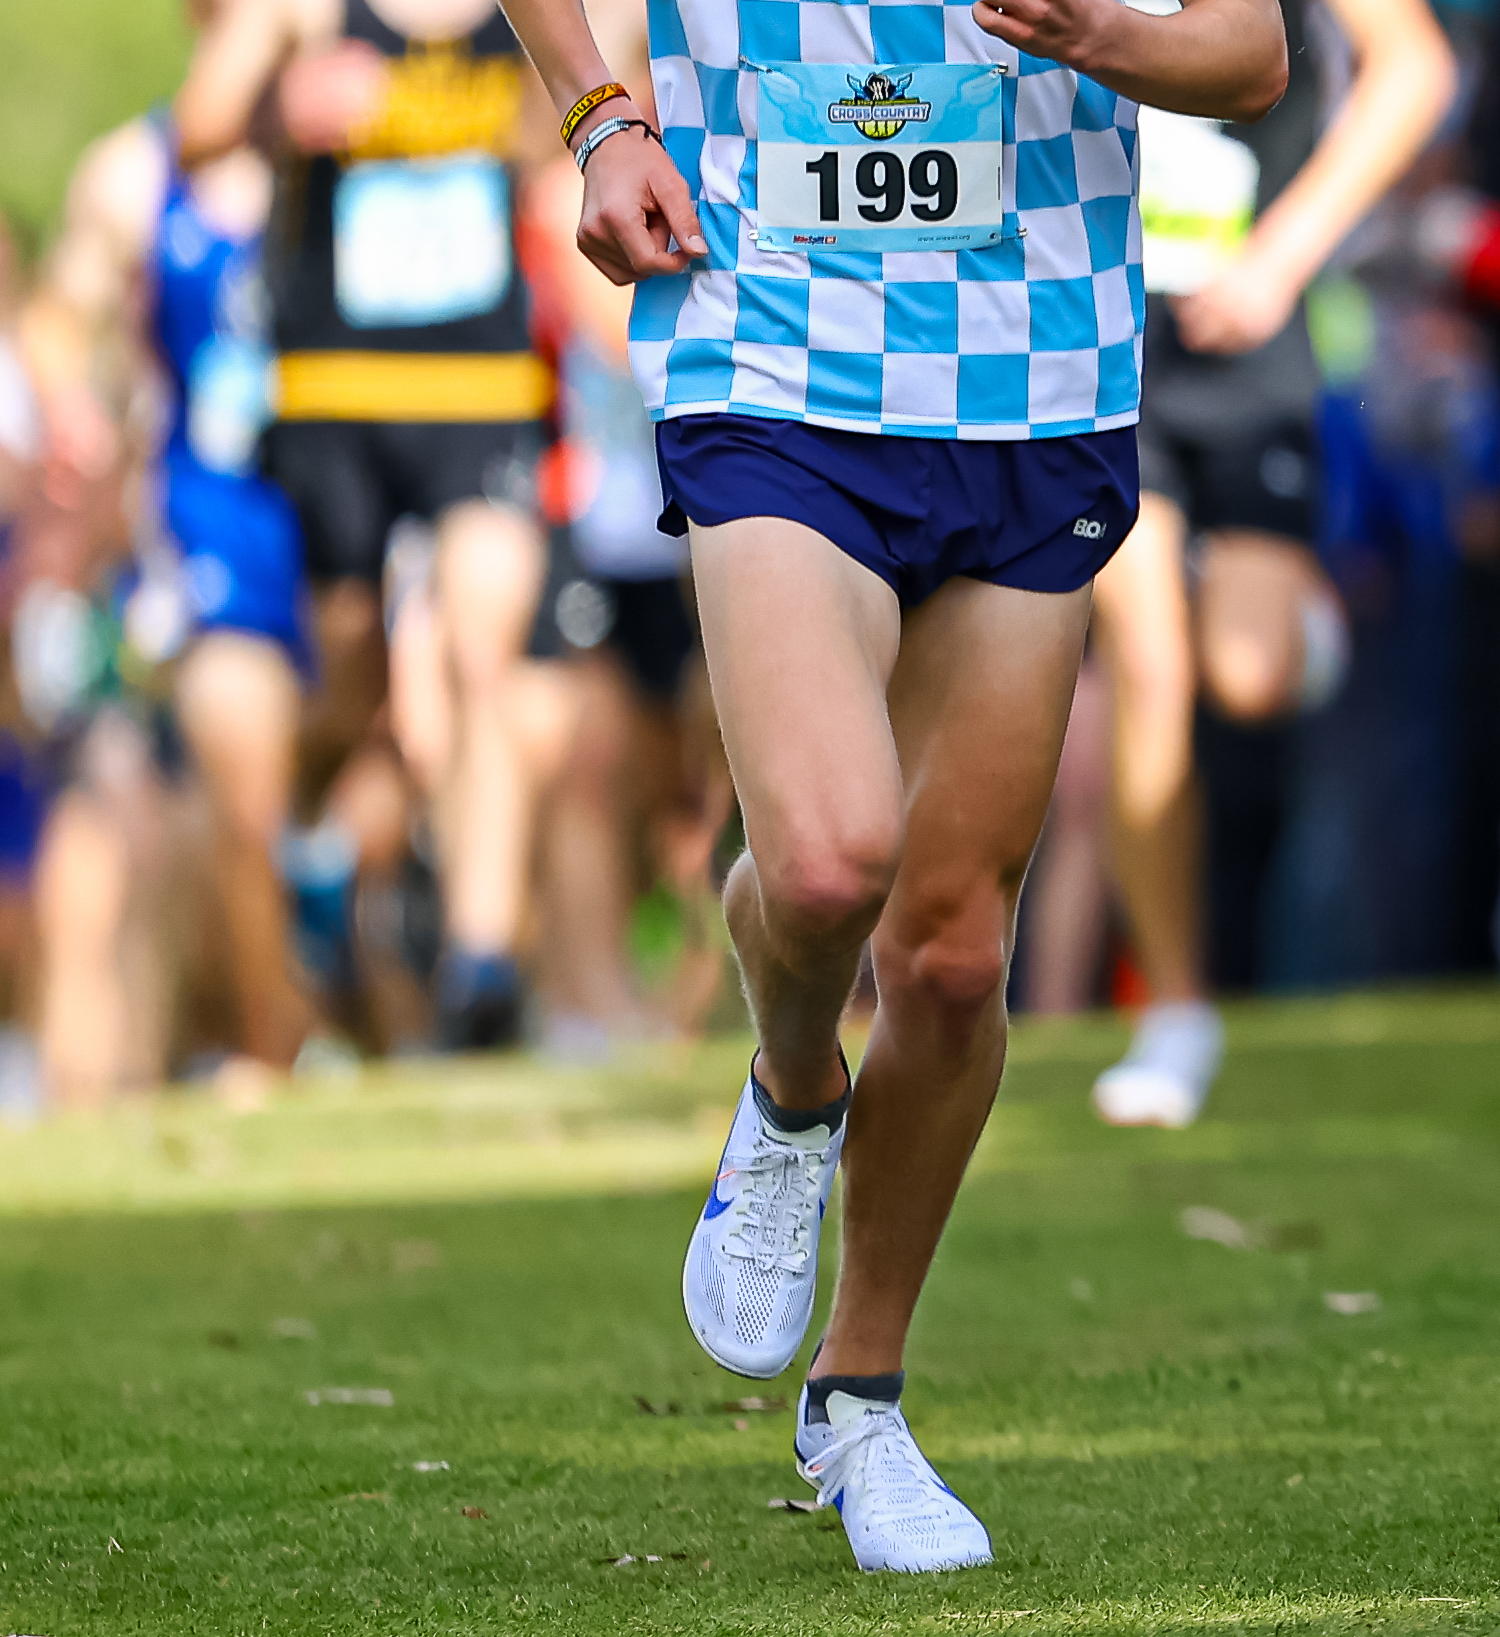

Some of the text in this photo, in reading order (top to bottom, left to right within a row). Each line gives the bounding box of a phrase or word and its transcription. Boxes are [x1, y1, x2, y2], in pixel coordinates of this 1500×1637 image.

[831, 106, 928, 120] CROSS COUNTRY
[806, 149, 959, 222] 199
